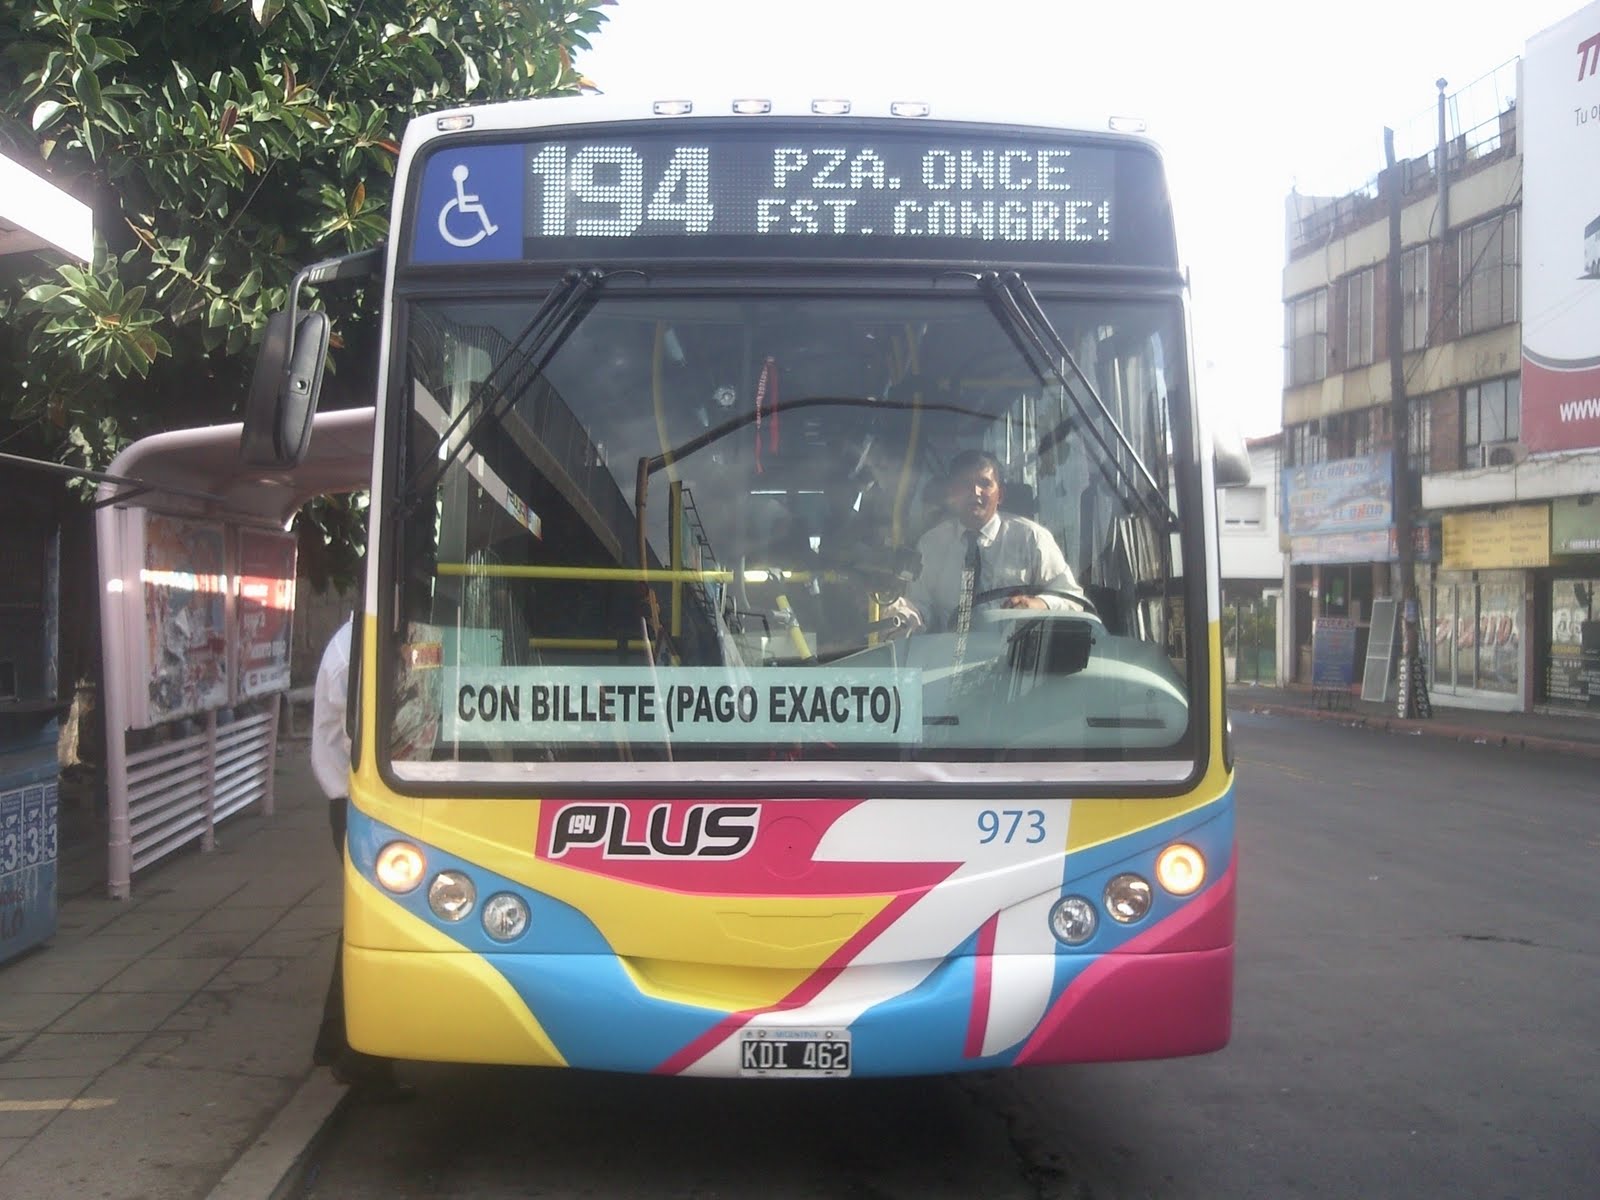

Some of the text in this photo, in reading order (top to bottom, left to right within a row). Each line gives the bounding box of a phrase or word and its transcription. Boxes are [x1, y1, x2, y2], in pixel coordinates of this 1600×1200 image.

[1574, 108, 1588, 126] Tu
[773, 148, 1072, 191] PZA. ONCE
[531, 146, 714, 237] 194
[457, 684, 902, 733] CON BILLETE (PAGO EXACTO)
[548, 803, 762, 861] PLUS
[568, 815, 597, 834] 194
[977, 809, 1046, 844] 973
[744, 1042, 847, 1068] KDI 462
